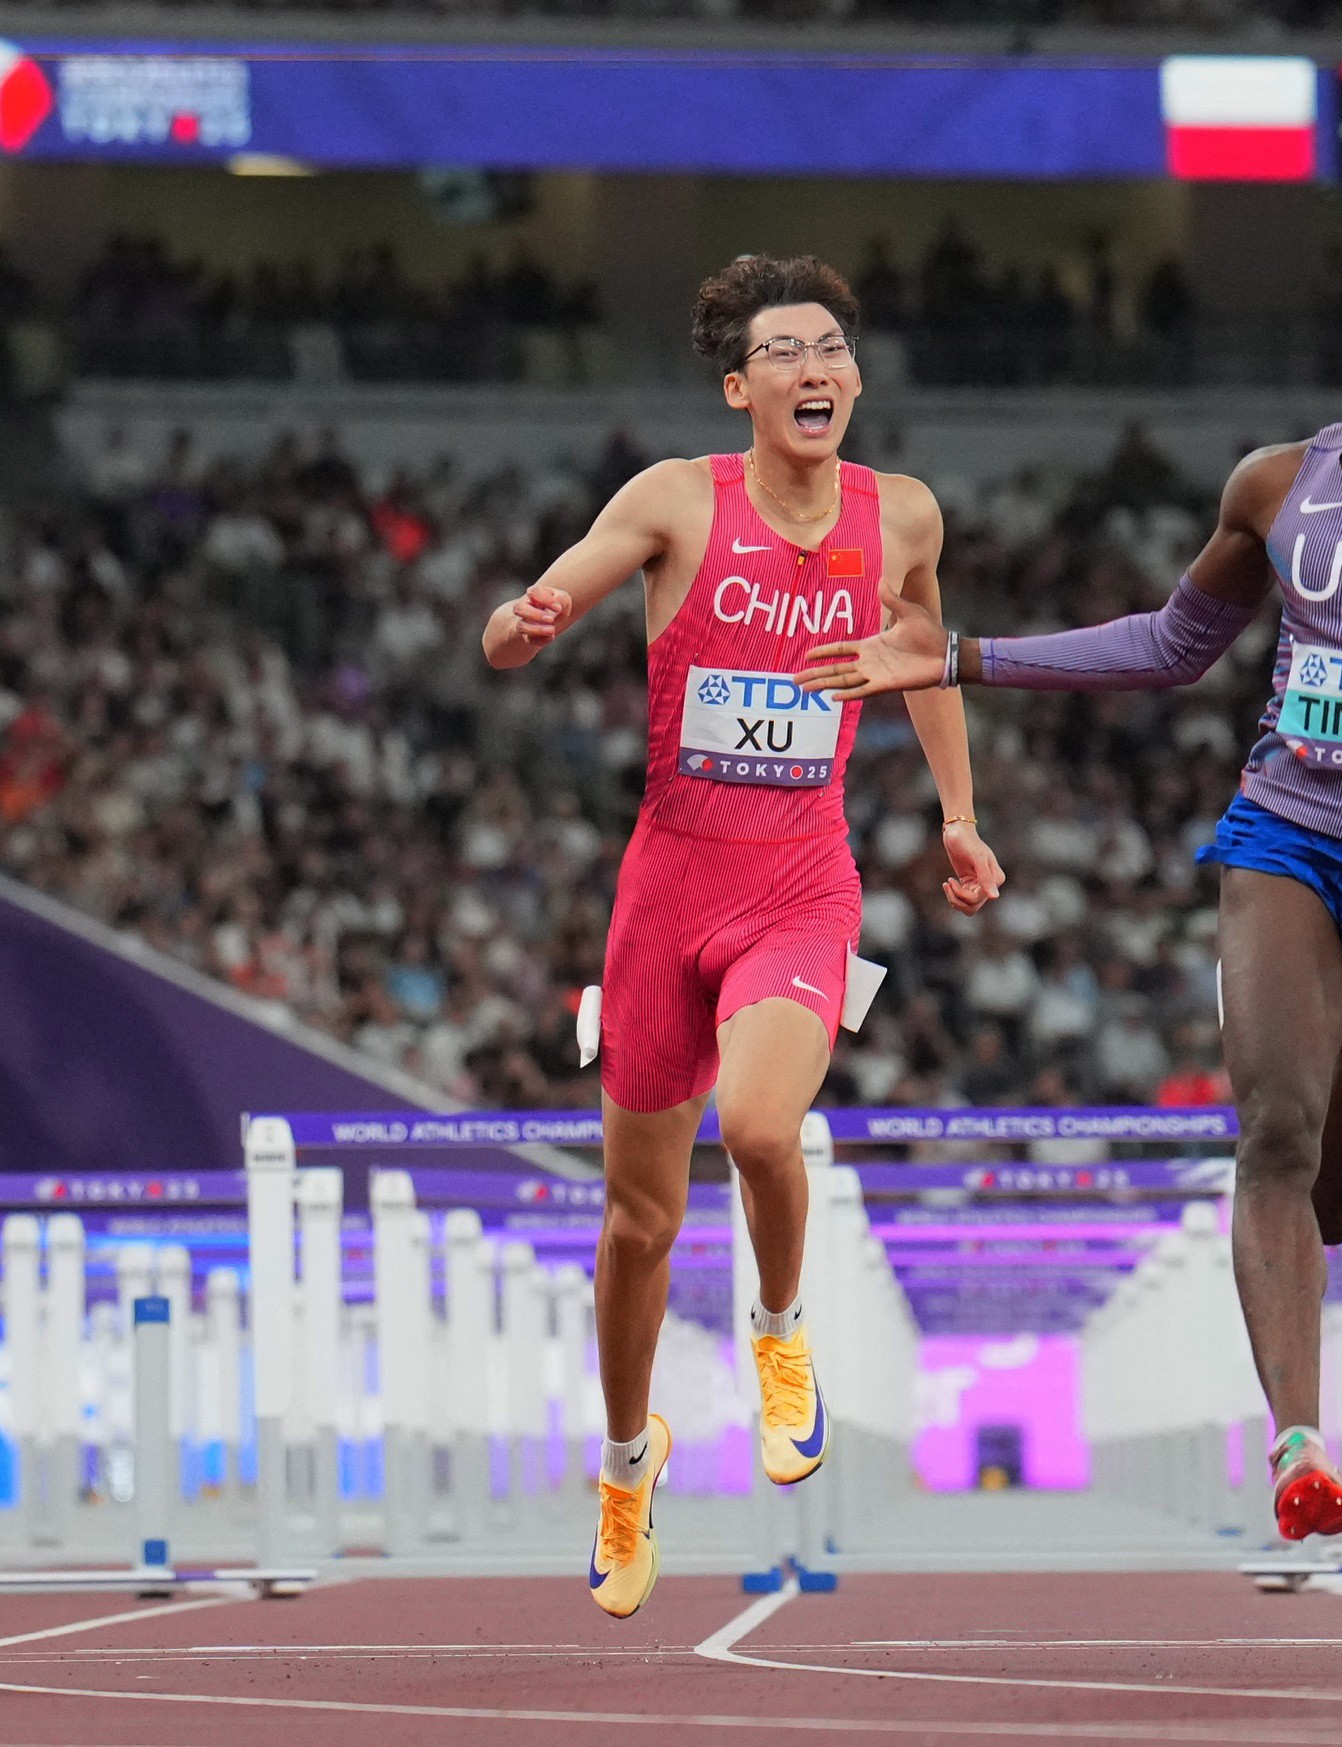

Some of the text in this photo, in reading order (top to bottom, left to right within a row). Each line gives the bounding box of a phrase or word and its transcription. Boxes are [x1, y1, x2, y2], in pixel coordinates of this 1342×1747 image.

[713, 575, 854, 638] CHINA
[734, 717, 794, 753] XU
[331, 1121, 408, 1142] WORLD
[410, 1120, 519, 1142] ATHLETICS
[867, 1114, 1227, 1138] WORLD ATHLETICS CHAMPIONSHIPS
